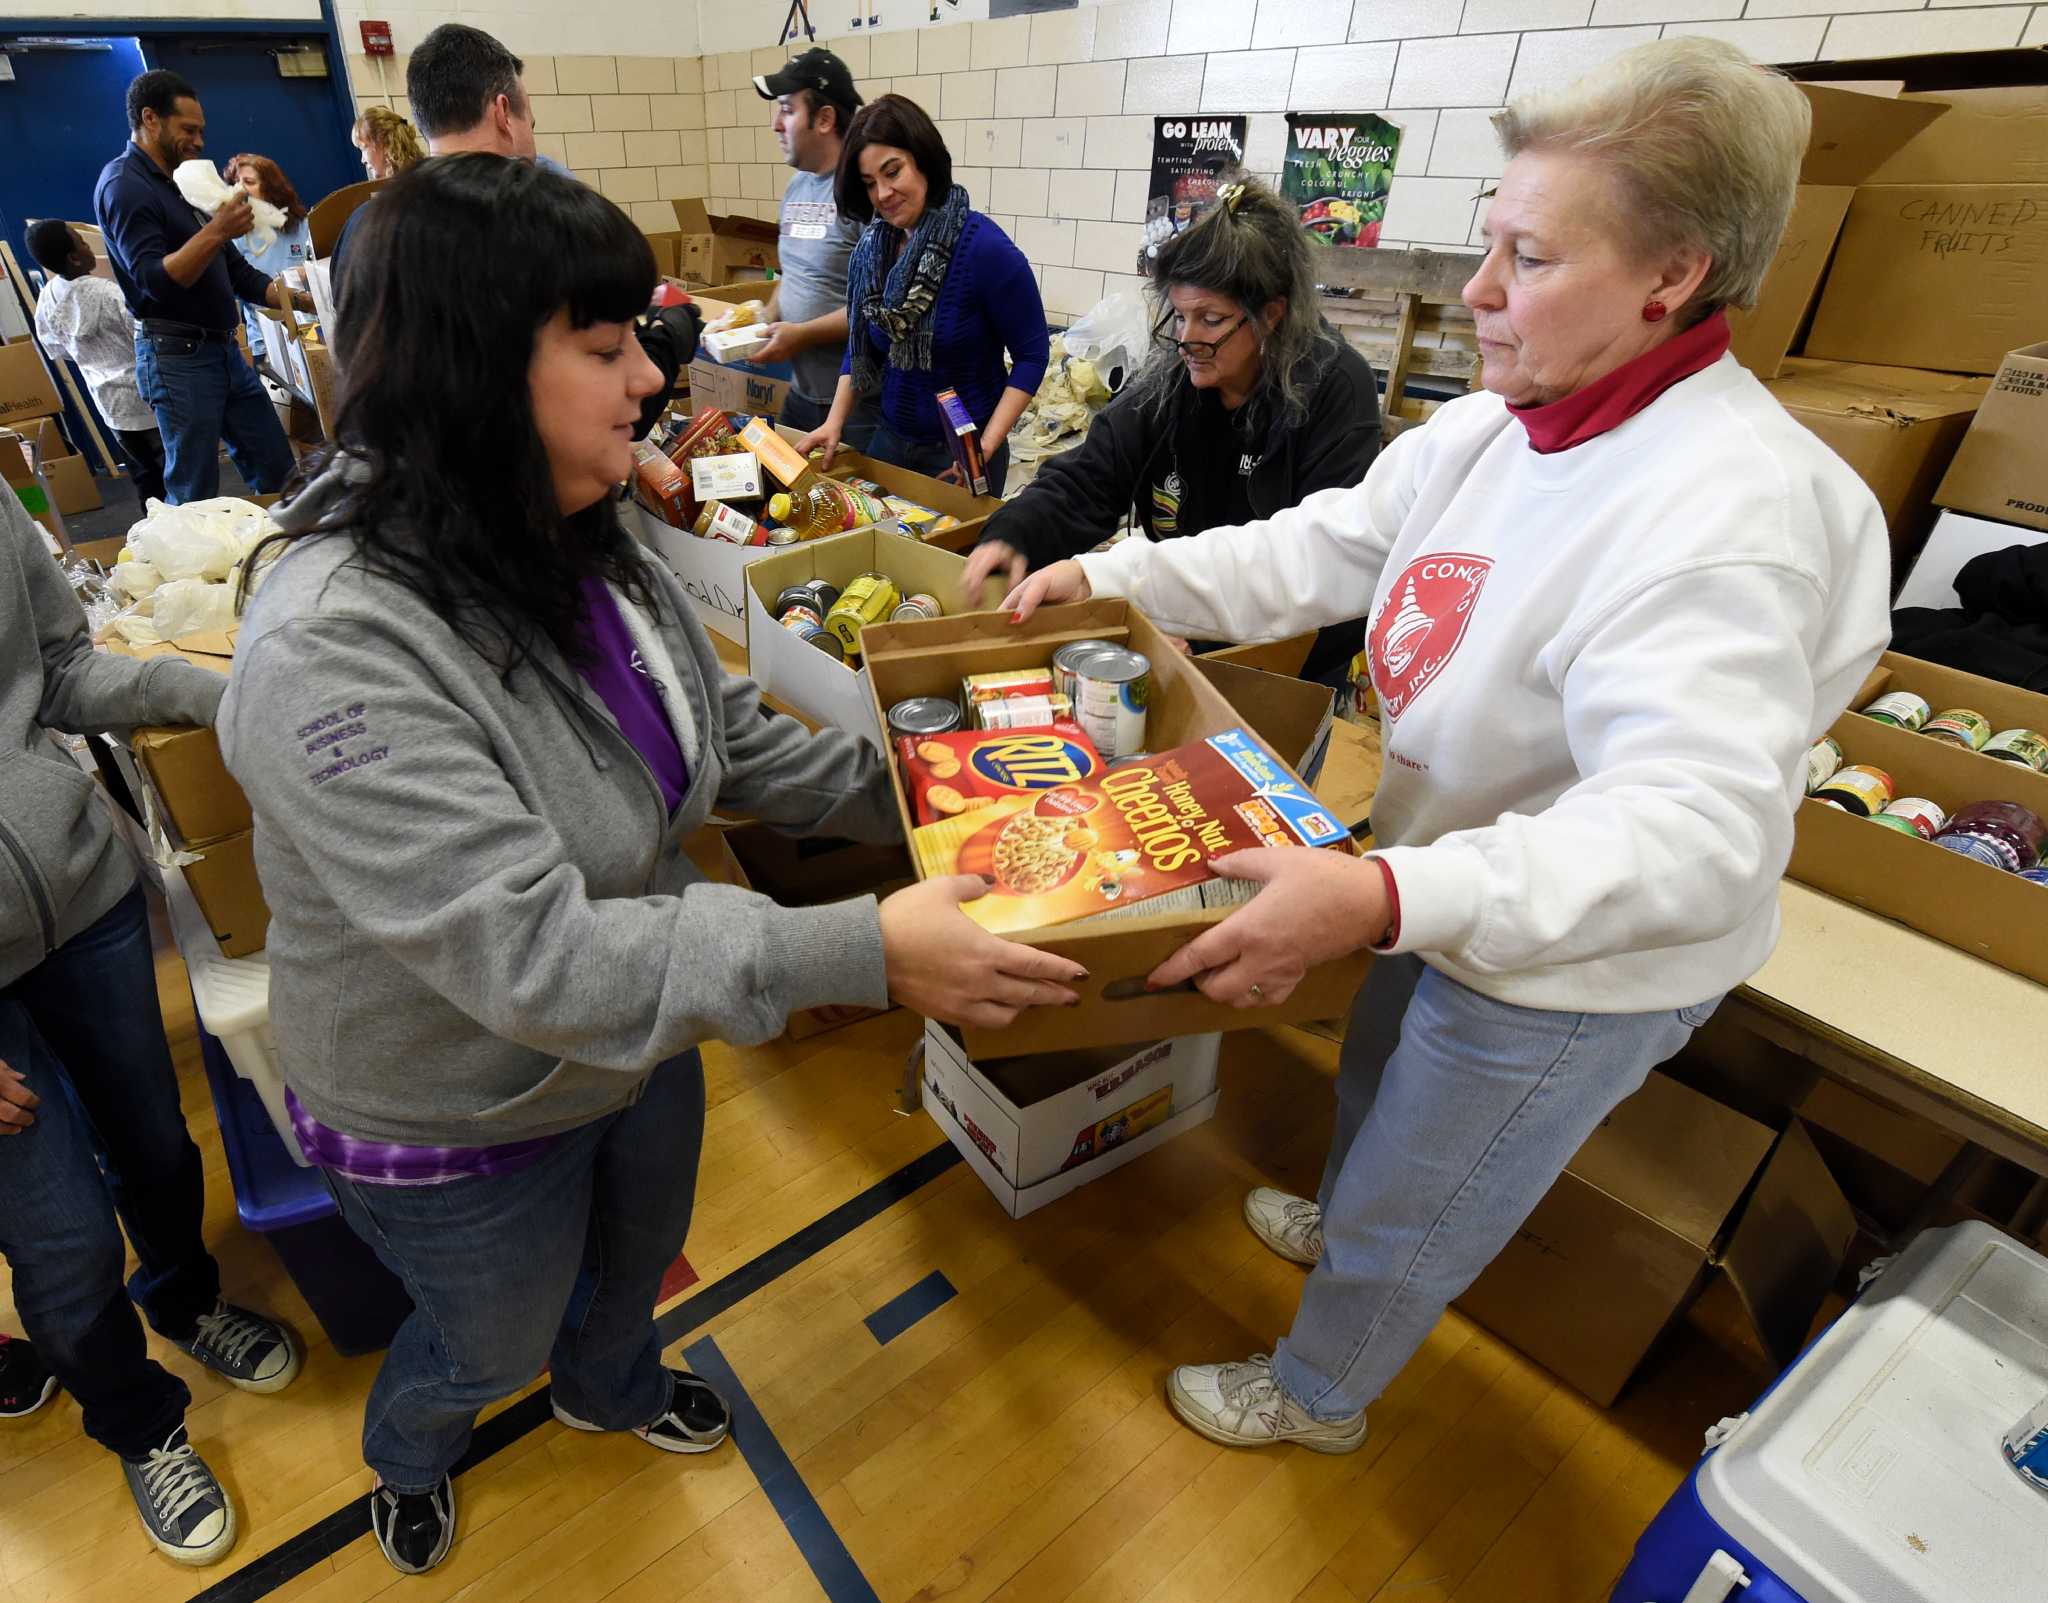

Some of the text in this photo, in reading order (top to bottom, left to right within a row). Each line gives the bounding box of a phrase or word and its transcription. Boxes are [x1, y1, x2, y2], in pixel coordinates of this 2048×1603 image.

[1162, 122, 1232, 139] GO LEAN
[1294, 127, 1356, 149] VARY
[1353, 136, 1370, 144] YOUR
[1157, 156, 1193, 164] TEMPTING
[1294, 160, 1321, 169] FRESH
[1327, 140, 1393, 169] veggies
[1170, 167, 1214, 175] SATISFYING
[1301, 180, 1347, 188] COLORFUL
[1326, 170, 1370, 179] CRUNCHY
[1341, 190, 1376, 198] BRIGHT
[1900, 199, 2037, 228] CANNED
[1920, 229, 2014, 260] FRUITS
[1409, 656, 1443, 693] INC.
[297, 702, 366, 740] SCHOOL OF
[305, 722, 367, 756] BUSINESS
[309, 746, 390, 785] TECHNOLOGY
[977, 735, 1082, 788] RITZ
[1100, 767, 1201, 872] Cheerios
[1162, 780, 1207, 820] Honey
[1193, 818, 1232, 852] Nut
